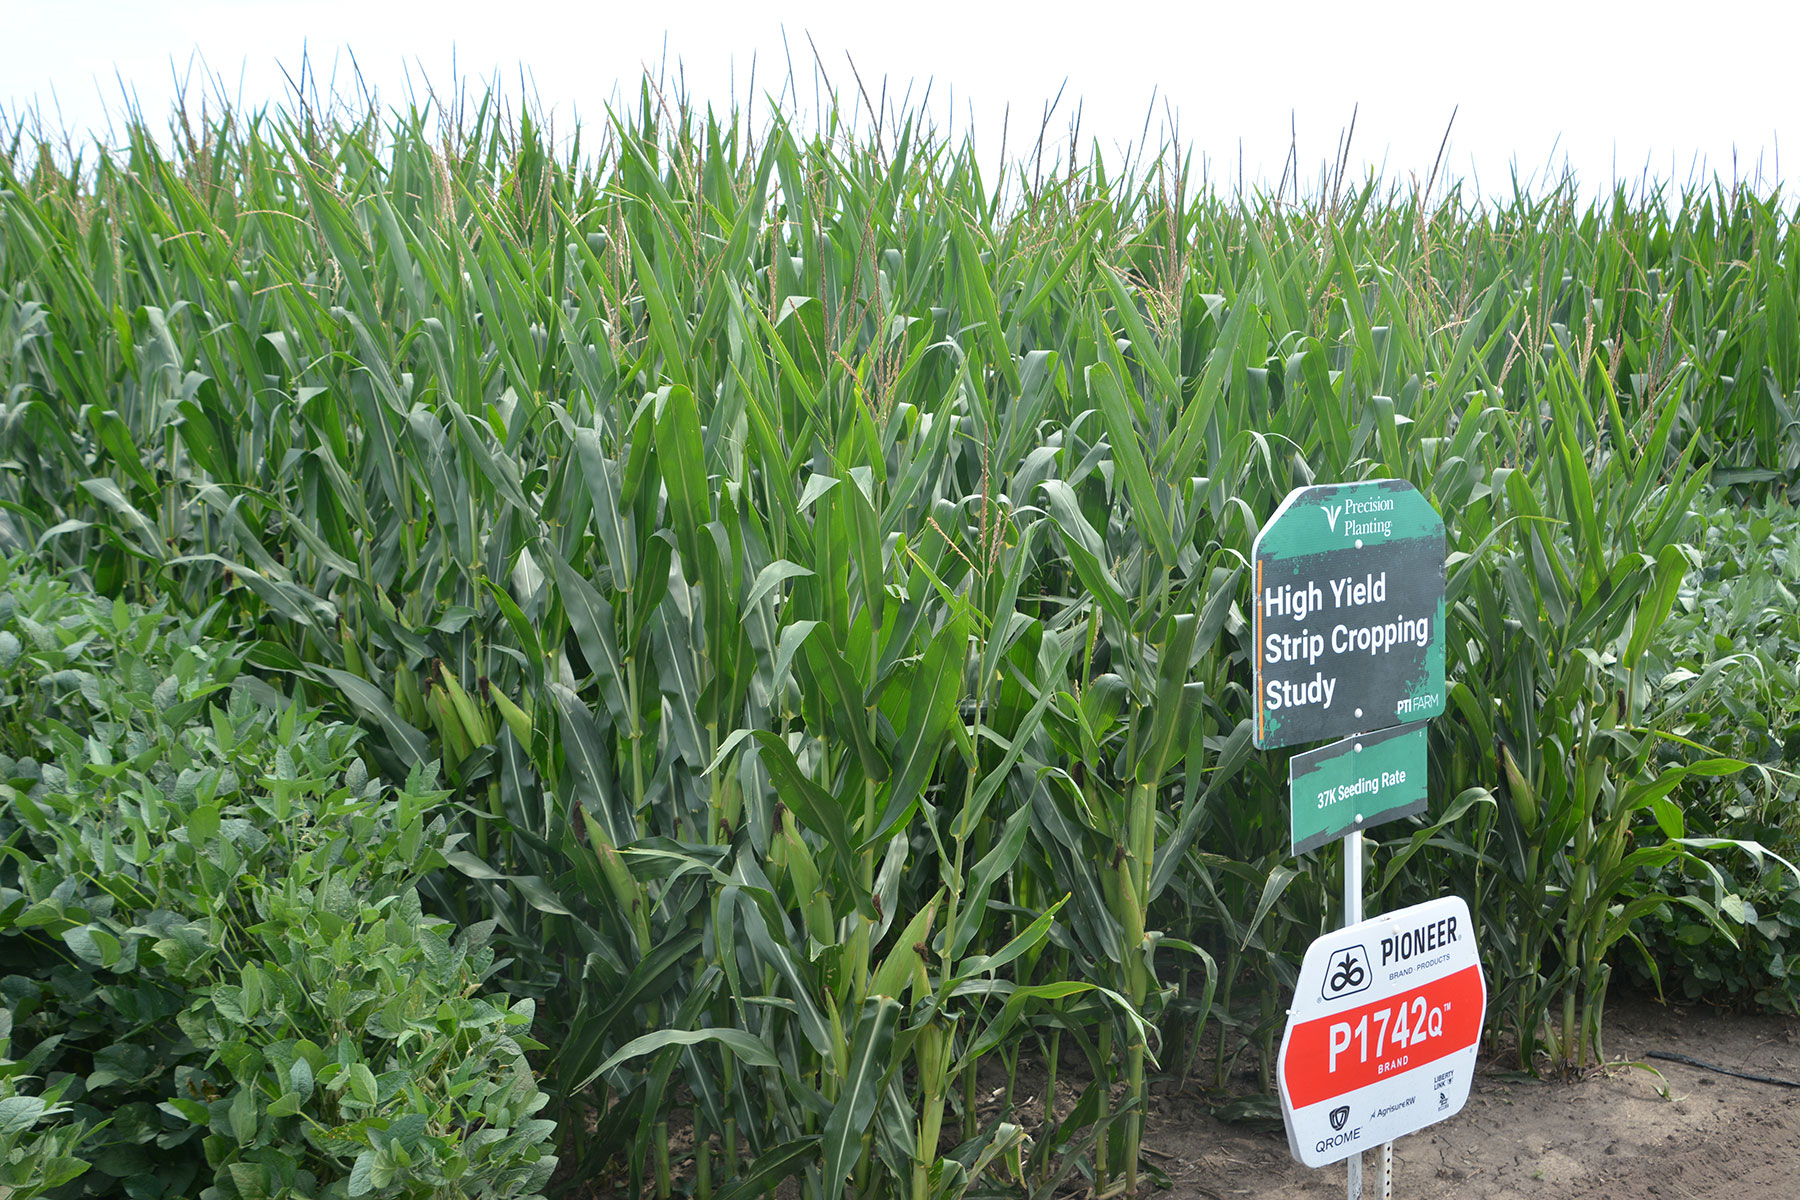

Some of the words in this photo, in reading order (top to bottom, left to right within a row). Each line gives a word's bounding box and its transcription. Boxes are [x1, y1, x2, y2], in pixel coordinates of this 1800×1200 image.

[1344, 496, 1394, 515] Precision
[1344, 518, 1392, 537] Planting
[1265, 581, 1323, 621] High
[1329, 572, 1386, 608] Yield
[1265, 628, 1325, 665] Strip
[1331, 614, 1429, 656] Cropping
[1266, 672, 1336, 710] Study
[1317, 788, 1336, 809] 37K
[1338, 777, 1379, 801] Seeding
[1381, 770, 1406, 788] Rate
[1381, 916, 1458, 966] PIONEER
[1389, 967, 1413, 981] BRAND
[1416, 953, 1451, 971] PRODUCTS
[1377, 1055, 1409, 1074] BRAND
[1434, 1069, 1454, 1083] LIBERTY
[1434, 1080, 1446, 1090] LINK
[1315, 1127, 1361, 1152] QROME
